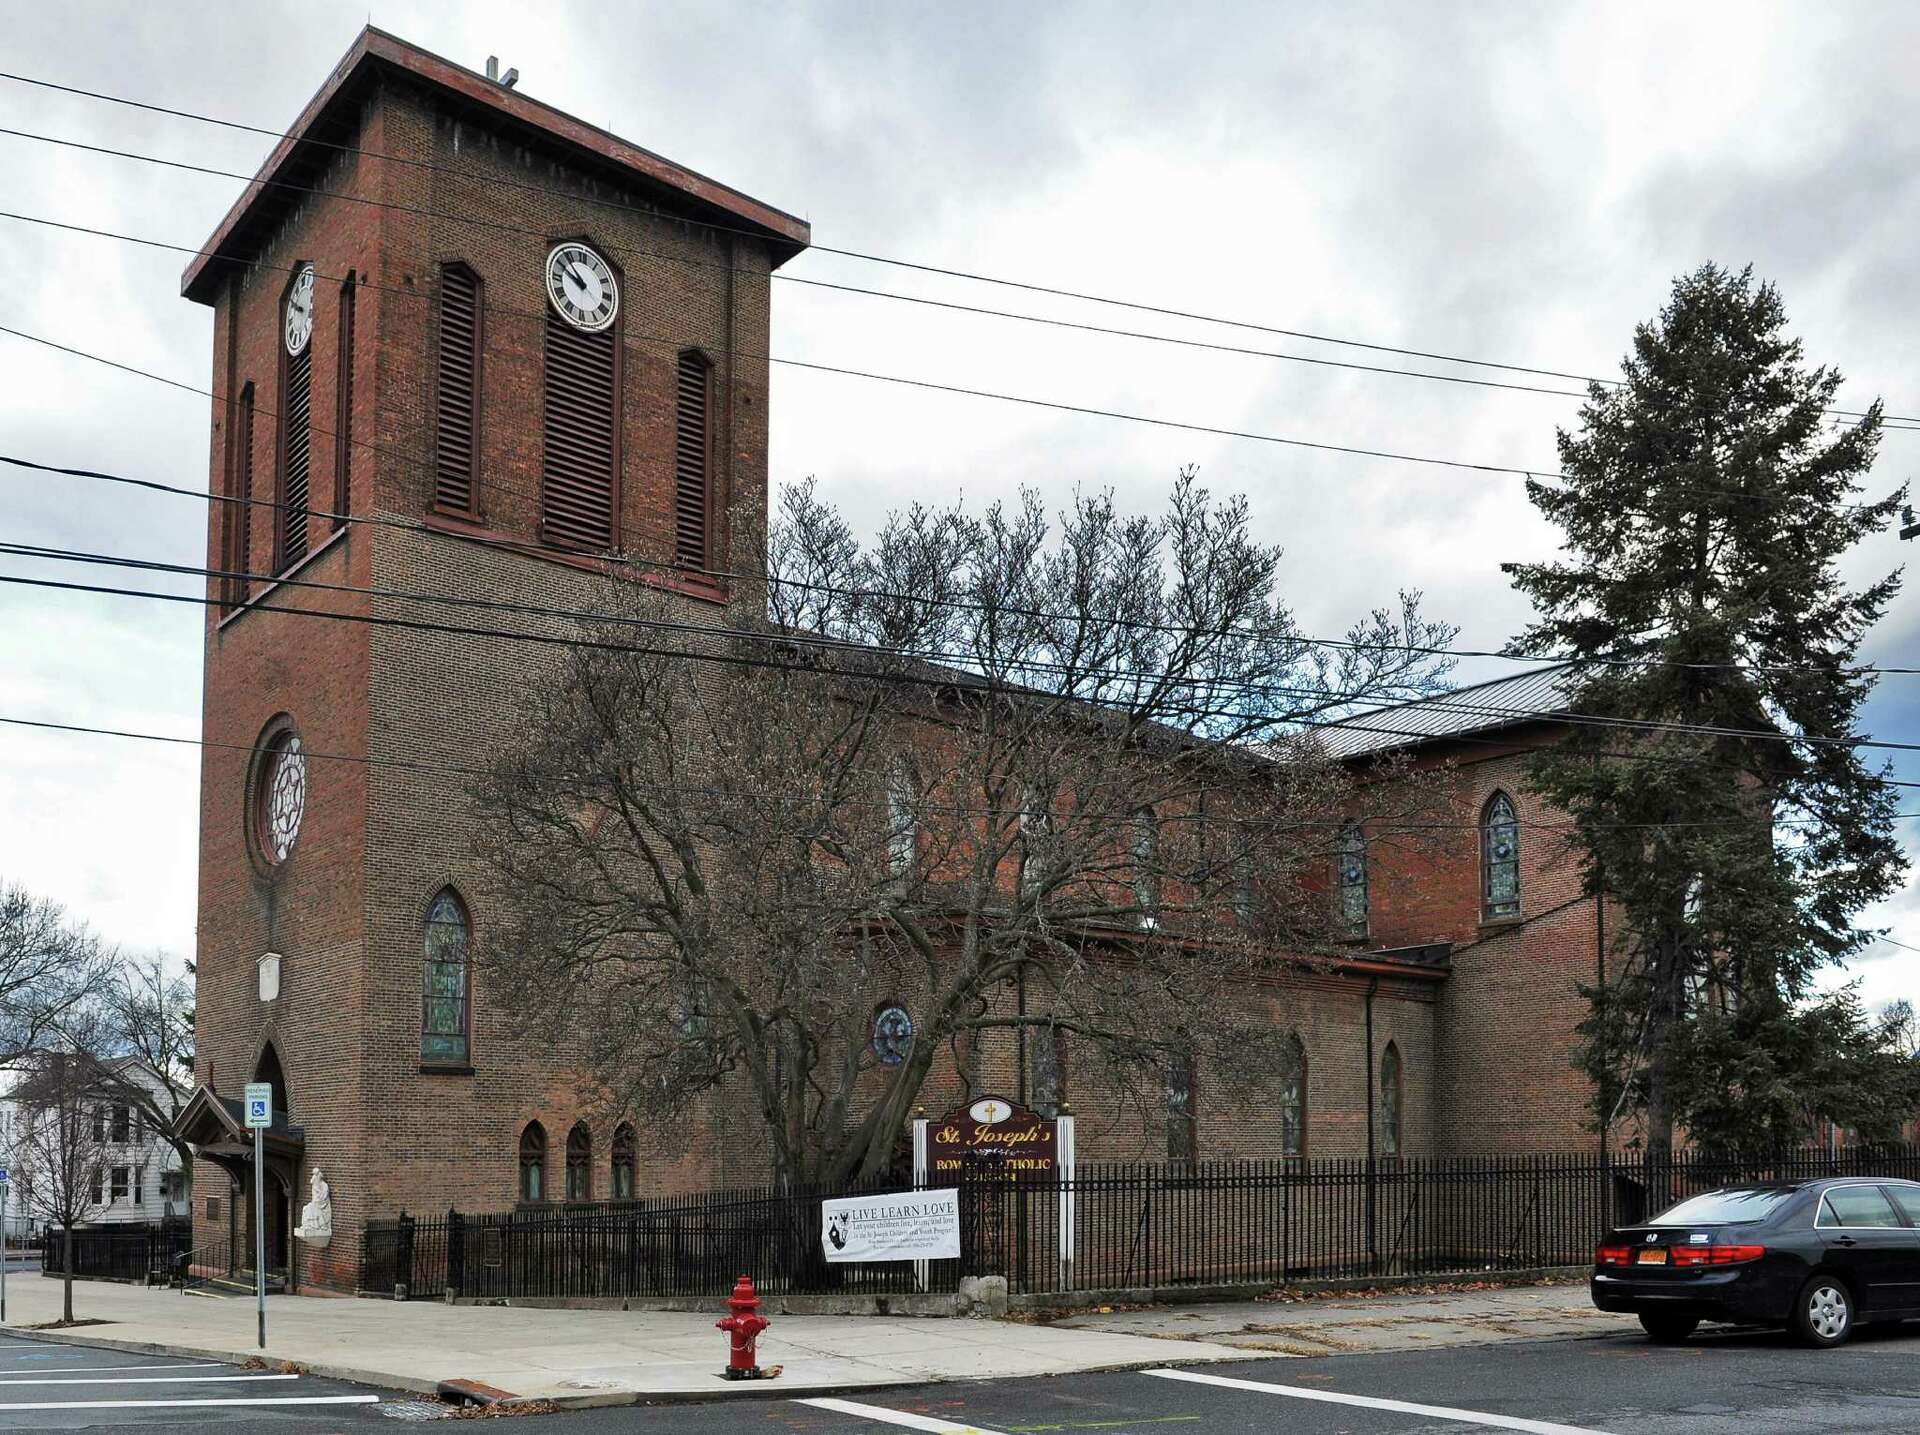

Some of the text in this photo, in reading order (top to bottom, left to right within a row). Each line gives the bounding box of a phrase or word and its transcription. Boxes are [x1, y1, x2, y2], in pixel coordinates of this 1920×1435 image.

[935, 1124, 1051, 1147] St. Joseph's
[852, 1202, 954, 1220] LIVE LEARN LOVE
